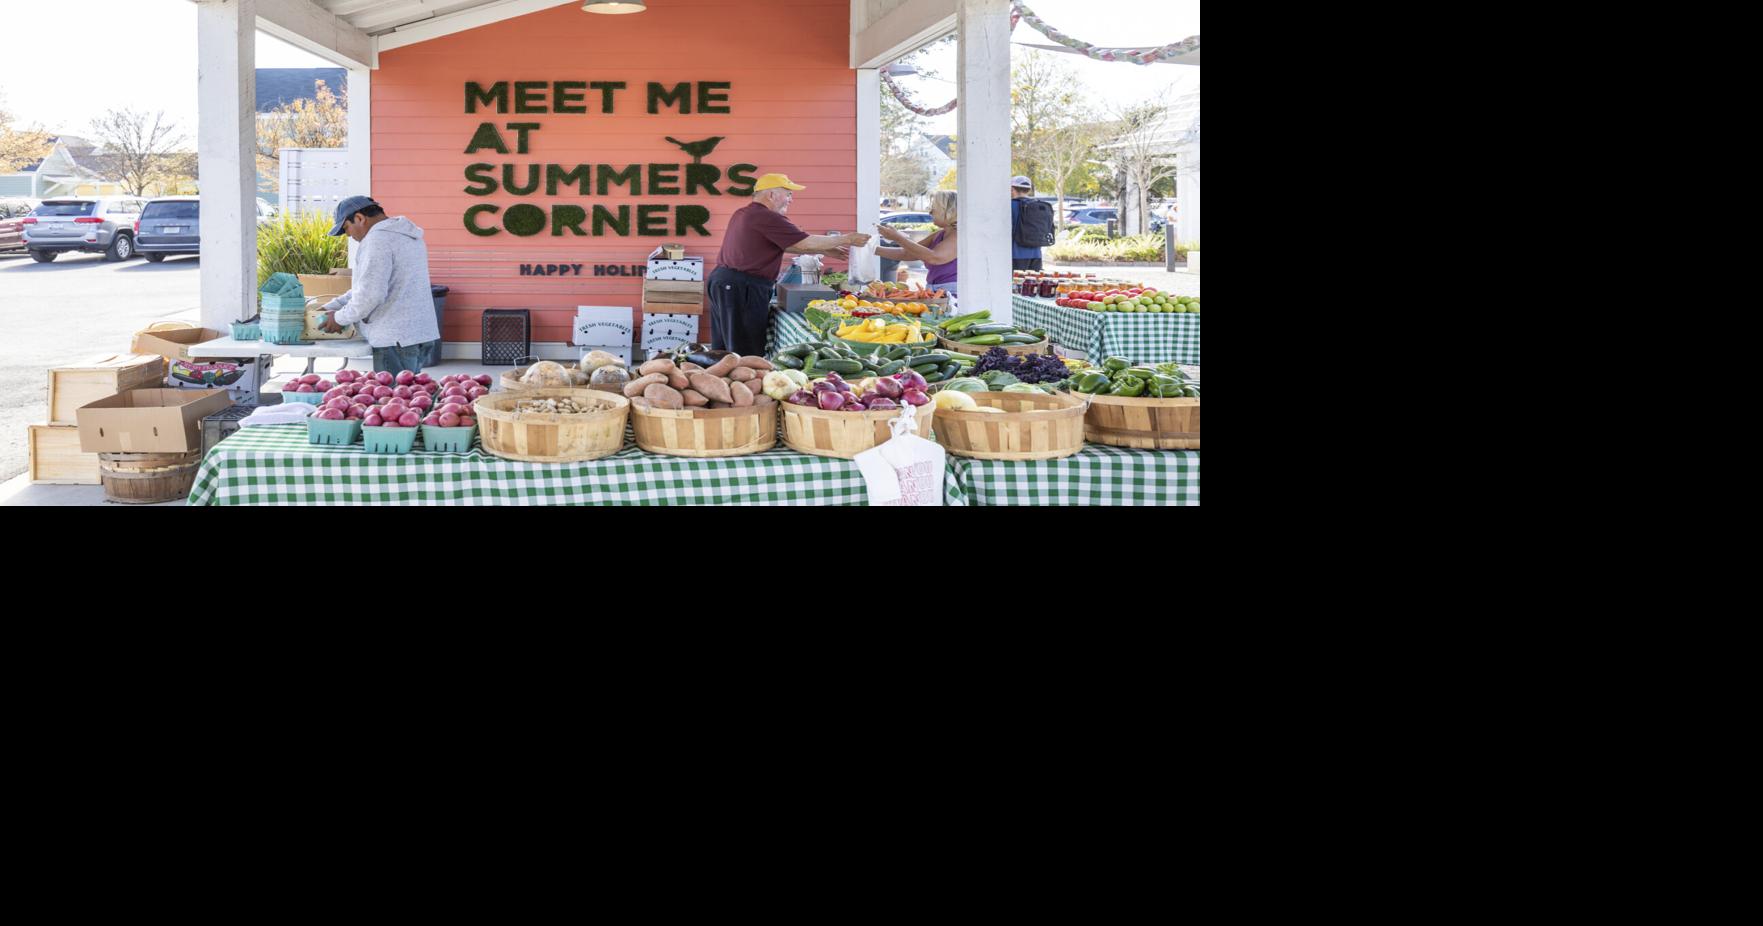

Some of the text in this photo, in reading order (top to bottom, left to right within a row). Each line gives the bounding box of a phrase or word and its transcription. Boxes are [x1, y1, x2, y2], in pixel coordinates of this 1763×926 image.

[464, 81, 731, 114] MEET ME
[463, 122, 540, 154] AT
[463, 163, 758, 196] SUMMERS
[463, 203, 711, 237] CORNER
[520, 264, 582, 276] HAPPY
[668, 265, 697, 276] VEGETABLES
[579, 321, 631, 333] FRESH VEGETABLES
